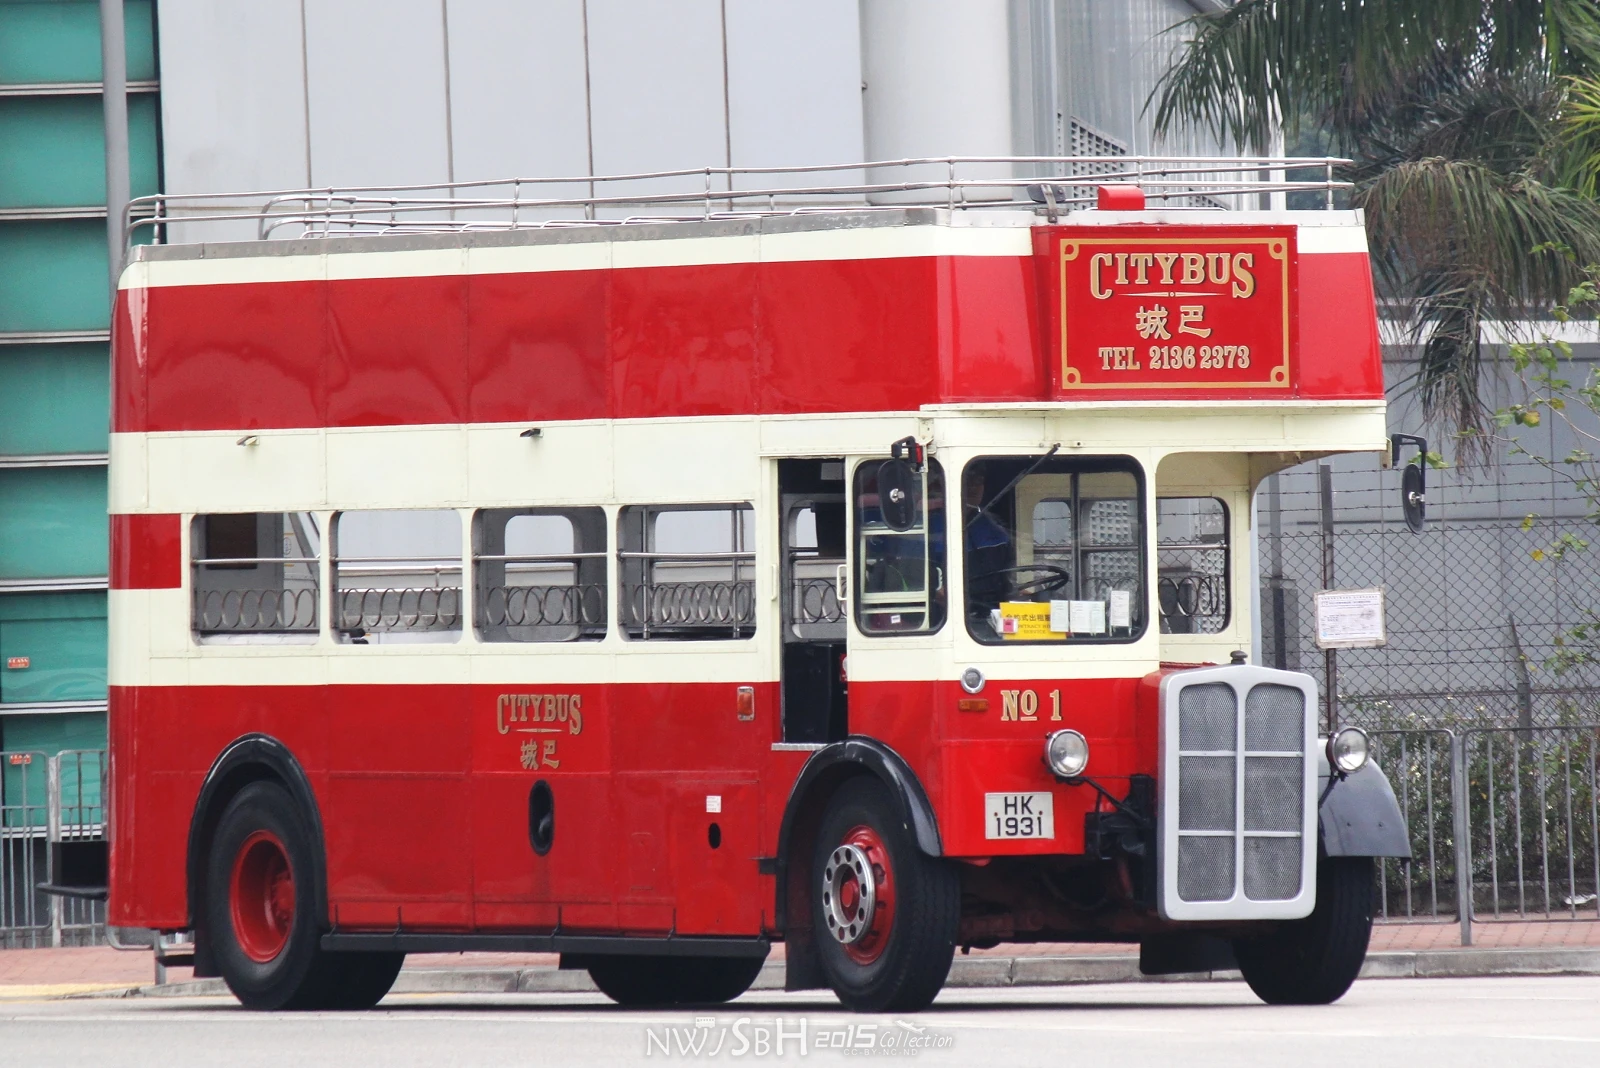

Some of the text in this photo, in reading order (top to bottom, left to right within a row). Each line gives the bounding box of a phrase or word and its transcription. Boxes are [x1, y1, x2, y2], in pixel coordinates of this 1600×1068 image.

[1090, 252, 1256, 300] CITYBUS
[1135, 303, 1212, 340] 城巴
[1098, 345, 1250, 370] TEL 2136 2373
[497, 694, 583, 735] CITYBUS
[1050, 689, 1062, 721] 1
[520, 738, 560, 770] 城巴
[1004, 795, 1034, 816] HK
[995, 816, 1042, 837] 1931
